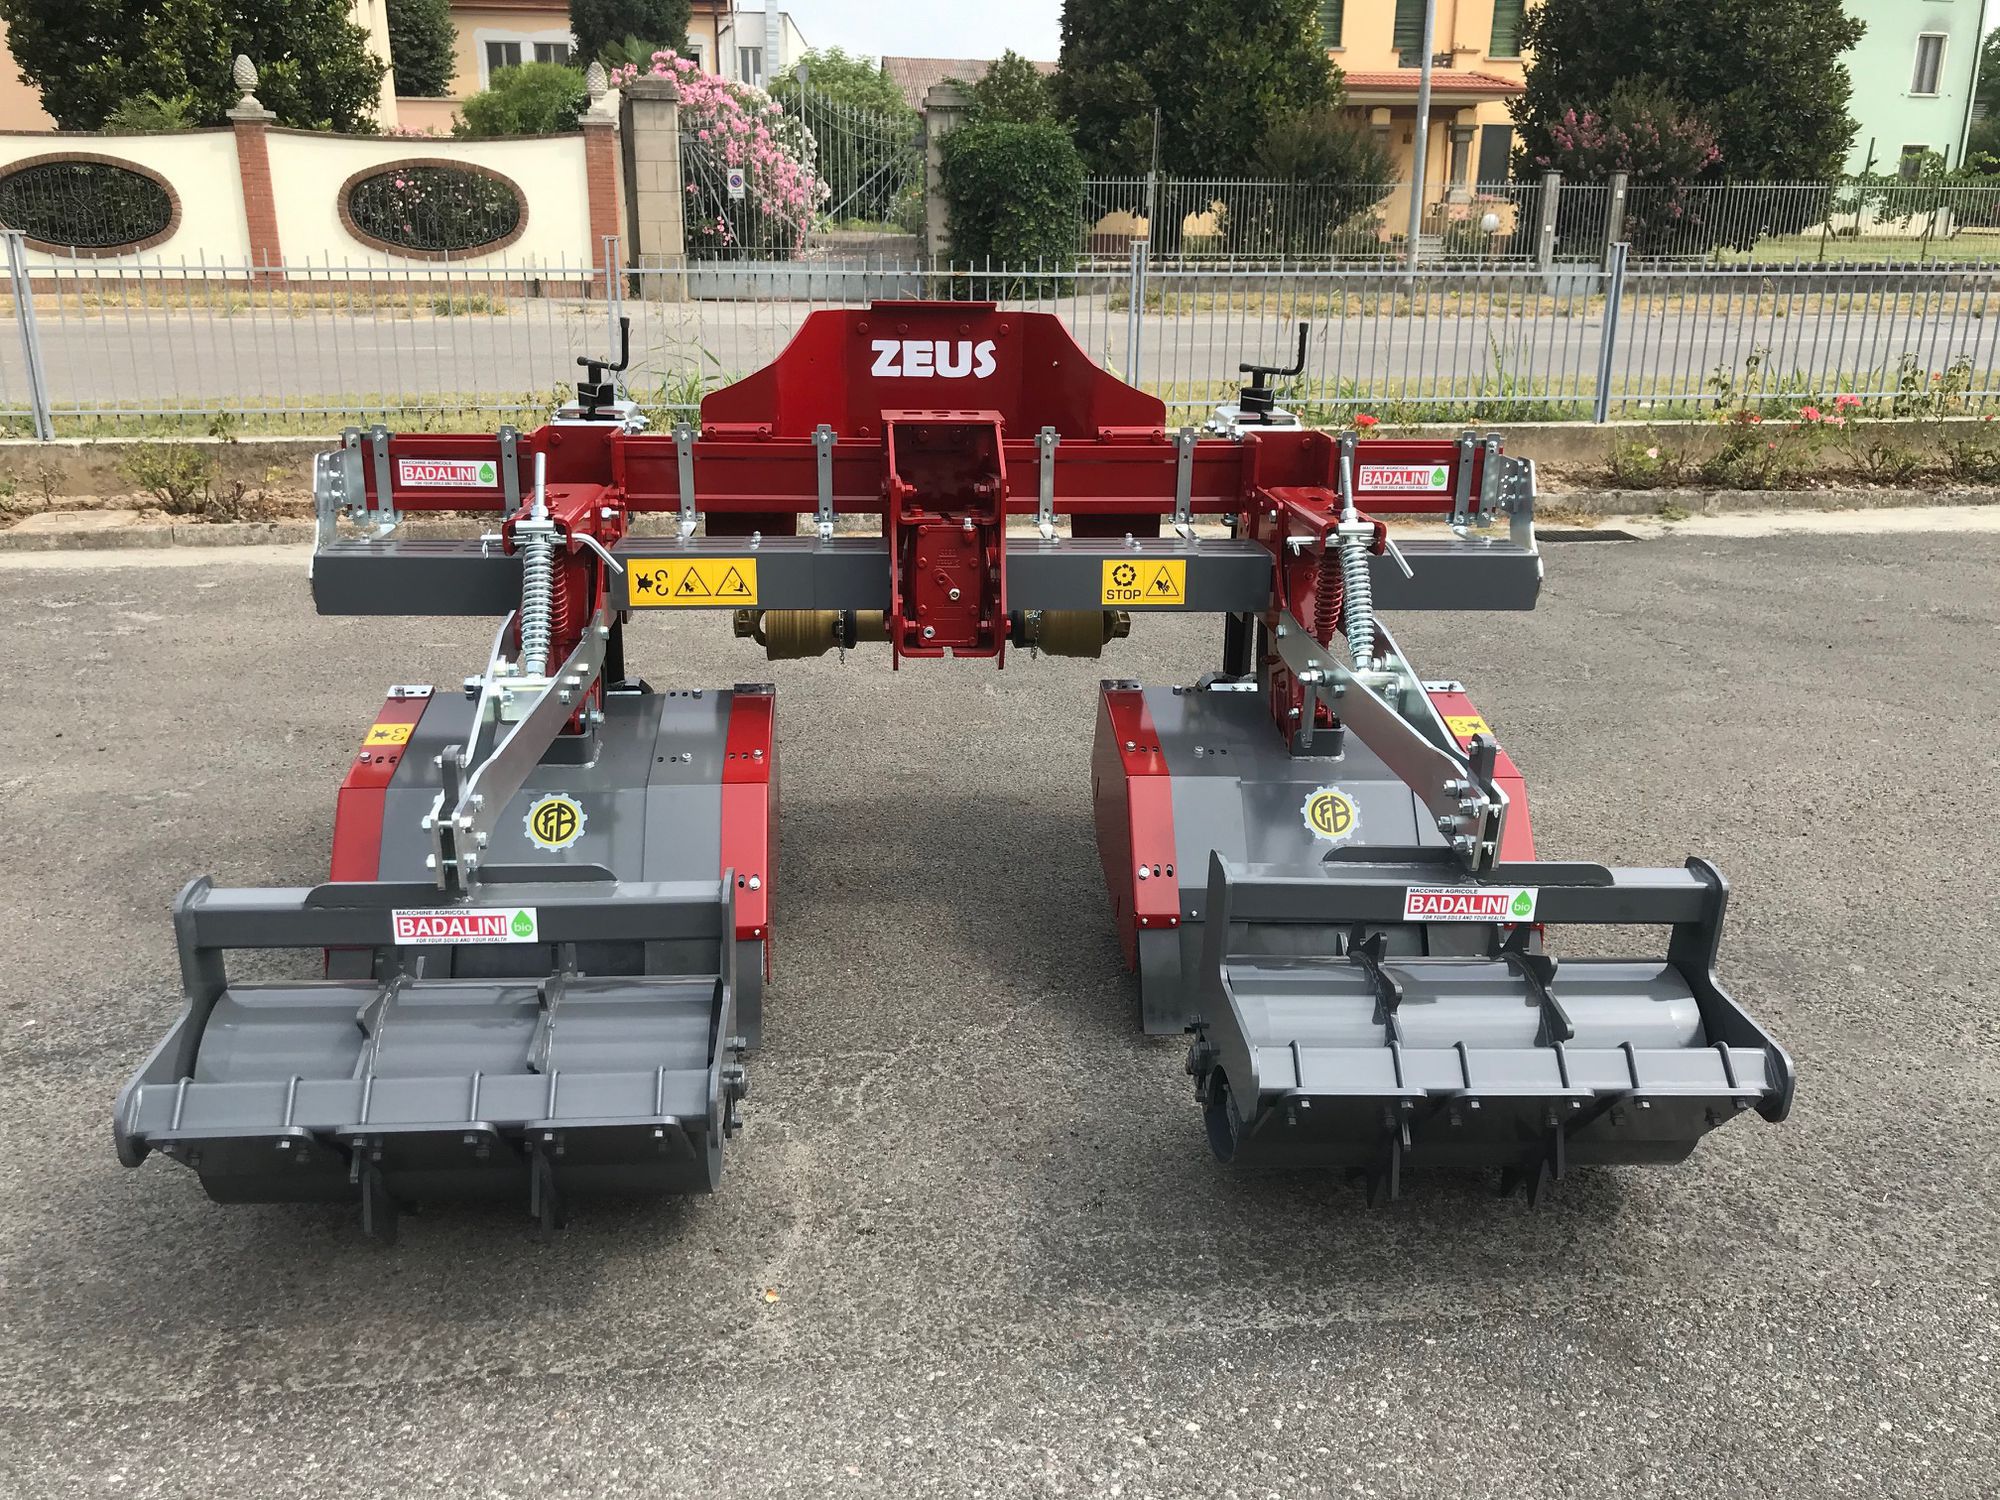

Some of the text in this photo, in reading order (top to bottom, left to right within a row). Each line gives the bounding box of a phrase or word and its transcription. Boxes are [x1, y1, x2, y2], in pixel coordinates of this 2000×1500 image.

[871, 339, 997, 379] ZEUS
[403, 466, 476, 481] BADALINI
[1362, 471, 1429, 485] BADALINI
[1106, 589, 1141, 600] STOP
[1409, 896, 1508, 914] BADALINI
[1513, 902, 1531, 912] bio
[399, 917, 506, 937] BADALINI
[513, 922, 532, 932] bio
